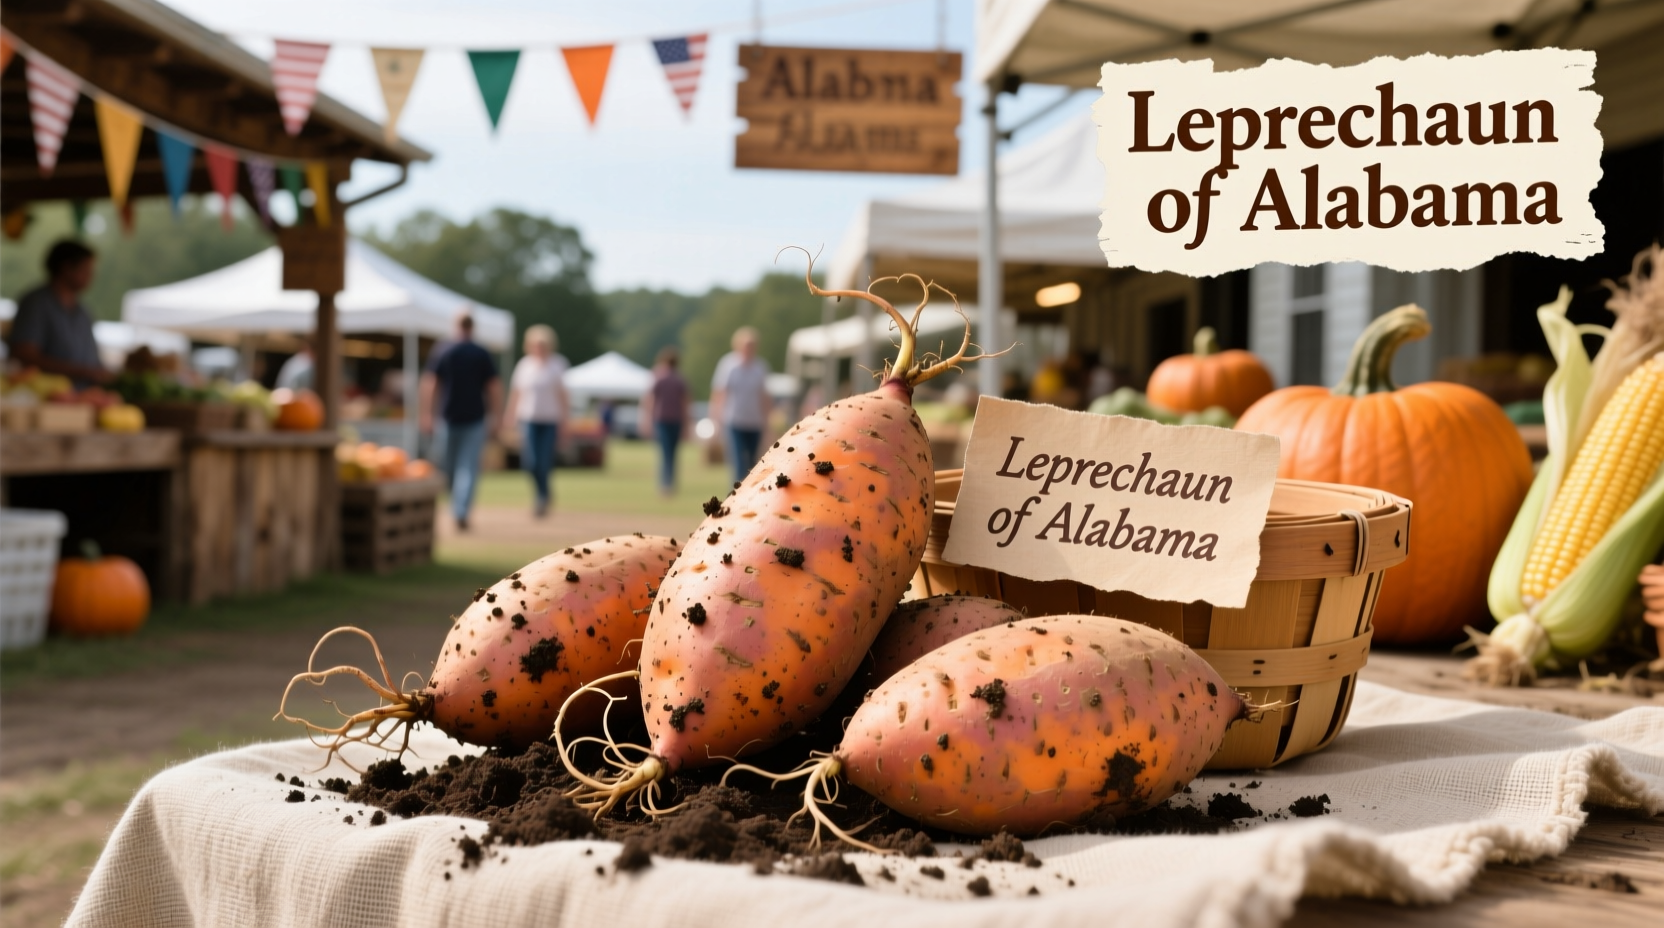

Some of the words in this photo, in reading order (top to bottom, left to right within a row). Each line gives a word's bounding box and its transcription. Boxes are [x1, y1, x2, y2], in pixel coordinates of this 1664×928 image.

[995, 435, 1233, 504] Leprechaun
[987, 496, 1042, 548] of
[1034, 501, 1219, 562] Alabama
